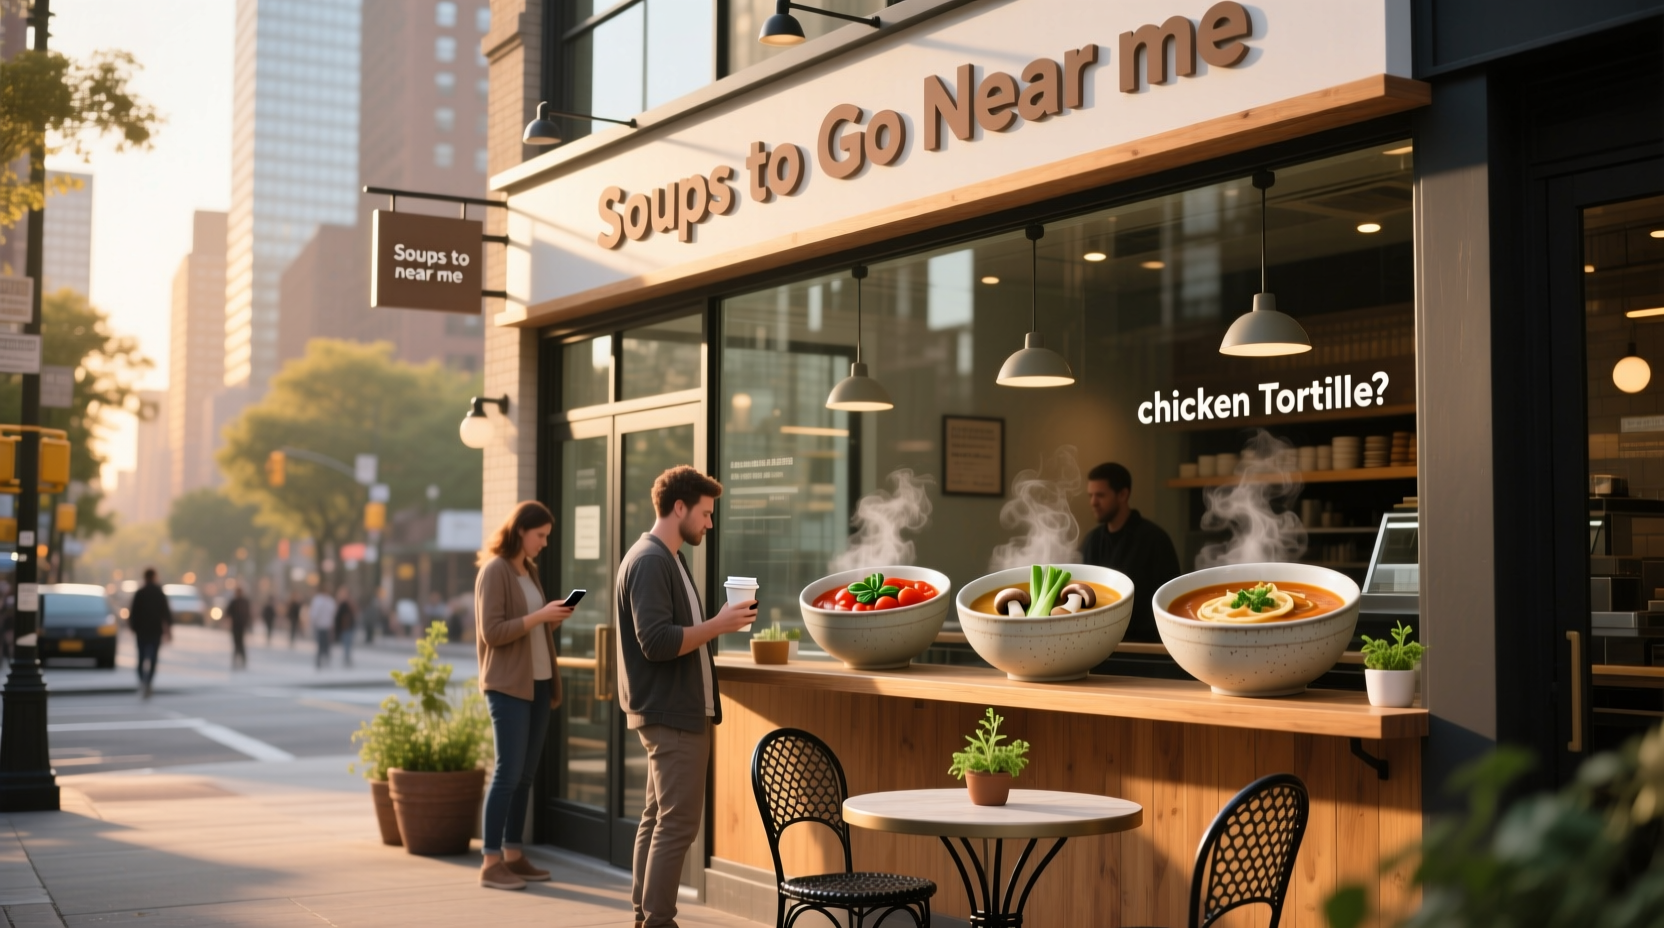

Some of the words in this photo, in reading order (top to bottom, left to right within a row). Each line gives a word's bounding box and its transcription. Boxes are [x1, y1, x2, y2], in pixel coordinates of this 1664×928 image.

[598, 164, 734, 249] Soups
[746, 140, 805, 202] to
[817, 103, 906, 179] Go
[923, 43, 1098, 152] Near
[1118, 1, 1252, 94] me
[394, 243, 447, 267] Soups
[451, 250, 470, 266] to
[394, 266, 434, 281] near
[437, 270, 463, 283] me
[1137, 386, 1250, 425] chicken
[1258, 371, 1389, 415] Tortille?
